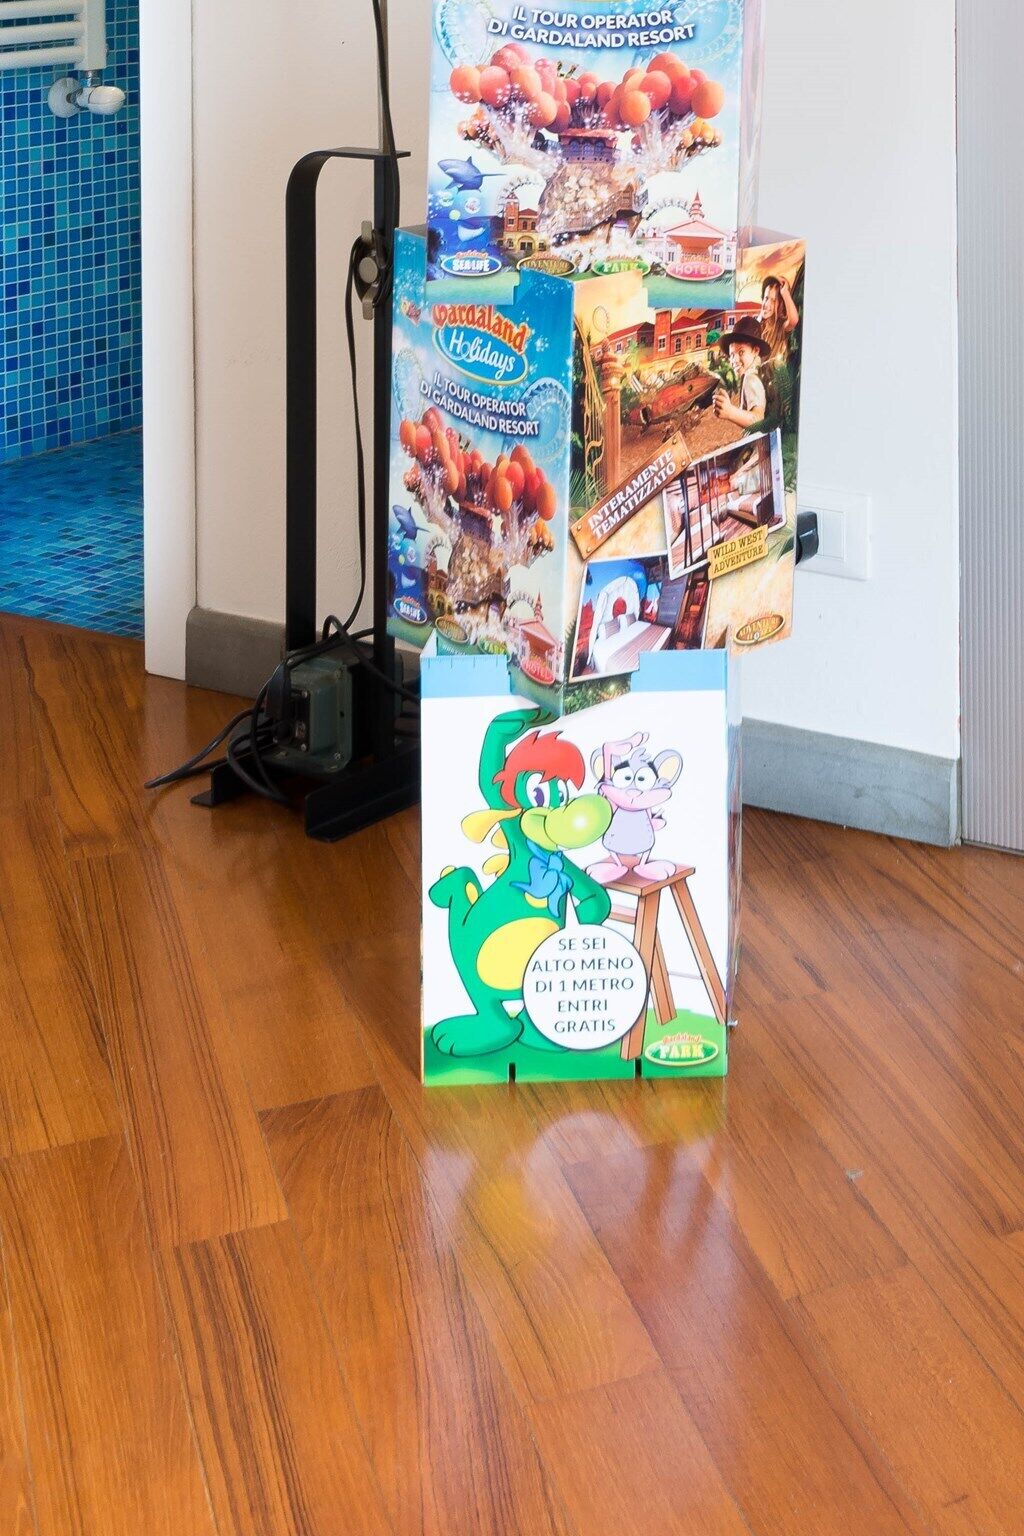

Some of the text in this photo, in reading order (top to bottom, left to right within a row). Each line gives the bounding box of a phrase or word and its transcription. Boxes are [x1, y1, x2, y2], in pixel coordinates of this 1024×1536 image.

[512, 6, 674, 30] IL TOUR OPERATOR
[488, 18, 696, 48] DI GARDALAND RESORT
[675, 264, 714, 276] HOTEL
[449, 329, 516, 380] Holidays
[433, 371, 526, 416] IL TOUR OPERATOR
[420, 380, 540, 436] DI GARDALAND RESORT
[588, 449, 674, 530] INTERAMENTE
[593, 461, 676, 540] TEMATIZZATO
[713, 530, 763, 559] WILD WEST
[713, 545, 763, 574] ADVENTURE
[558, 937, 606, 951] SE SEI
[531, 957, 634, 972] ALTO MENO
[535, 977, 634, 993] DI 1 METRO
[557, 999, 608, 1012] ENTRI
[554, 1019, 616, 1033] GRATIS
[659, 1043, 705, 1059] PARK
